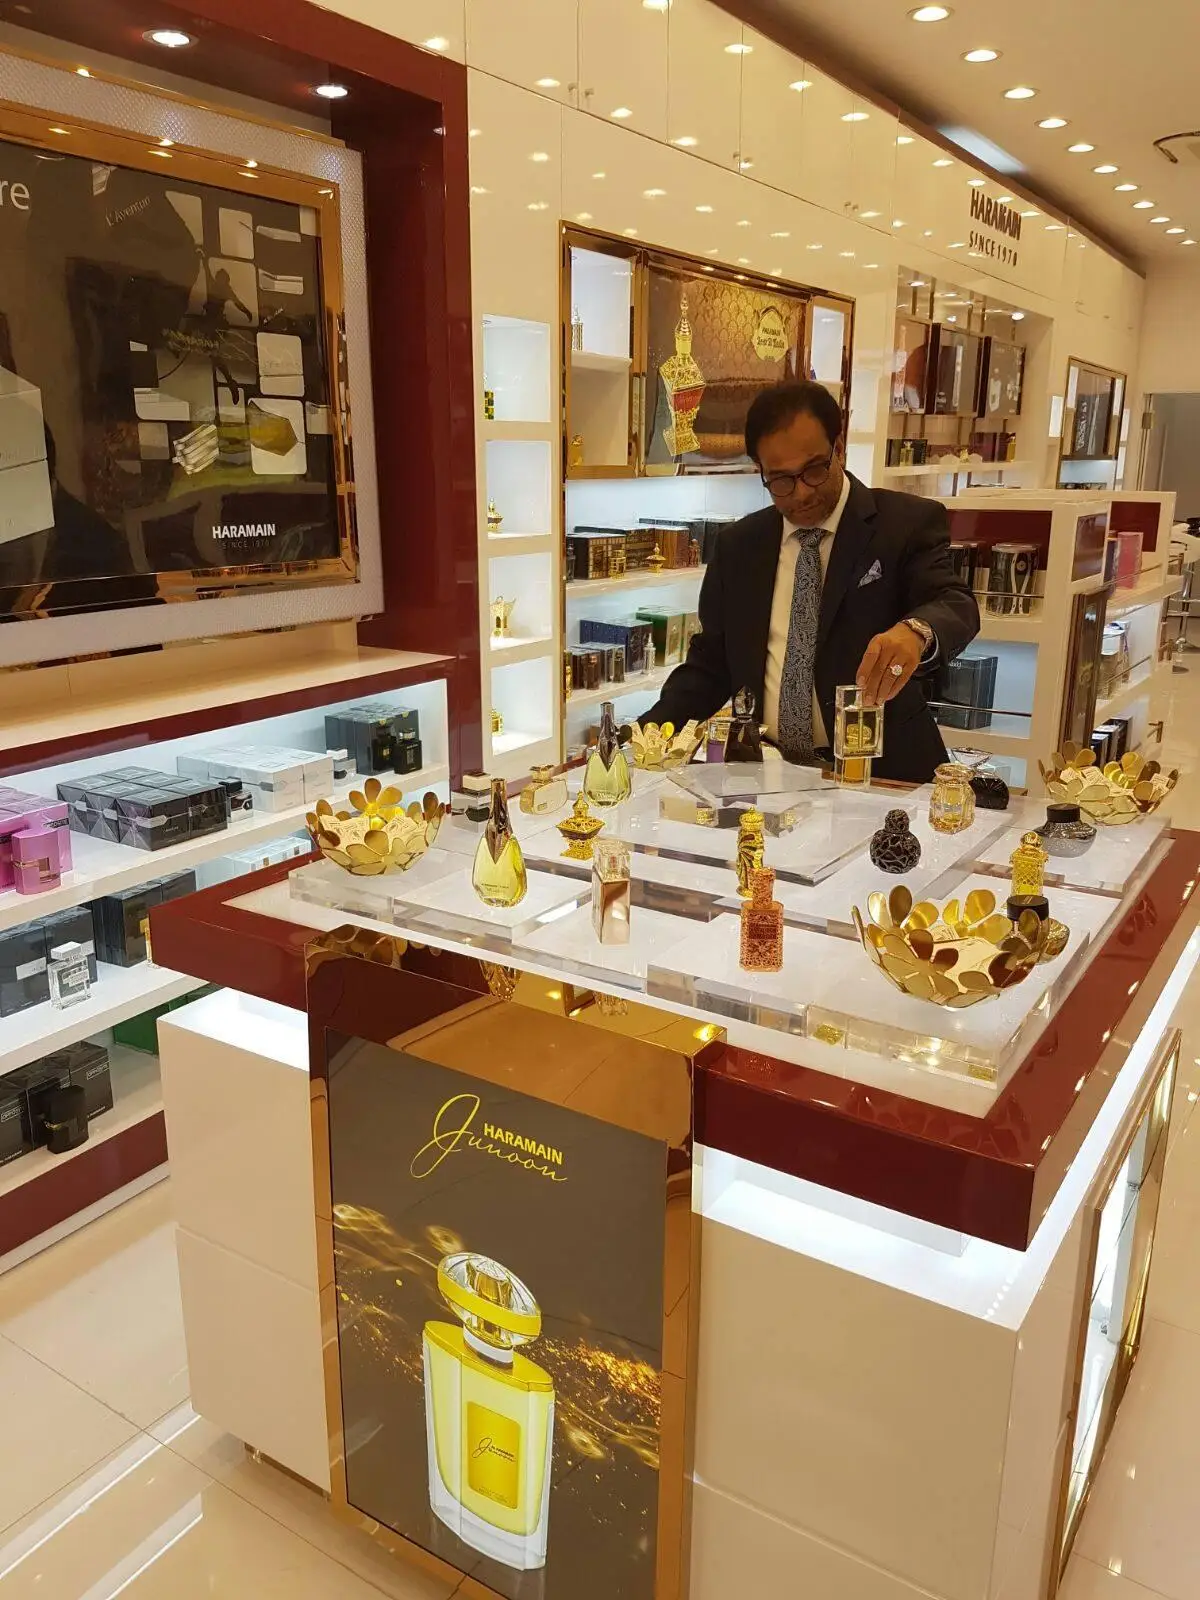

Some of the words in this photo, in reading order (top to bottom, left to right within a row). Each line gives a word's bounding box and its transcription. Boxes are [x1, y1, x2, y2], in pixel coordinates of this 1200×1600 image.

[970, 188, 1021, 241] HARAMAIN
[969, 230, 996, 257] SINCE
[997, 244, 1017, 267] 1970
[211, 523, 276, 539] HARAMAIN
[410, 1093, 568, 1182] Junoon
[483, 1122, 563, 1166] HARAMAIN
